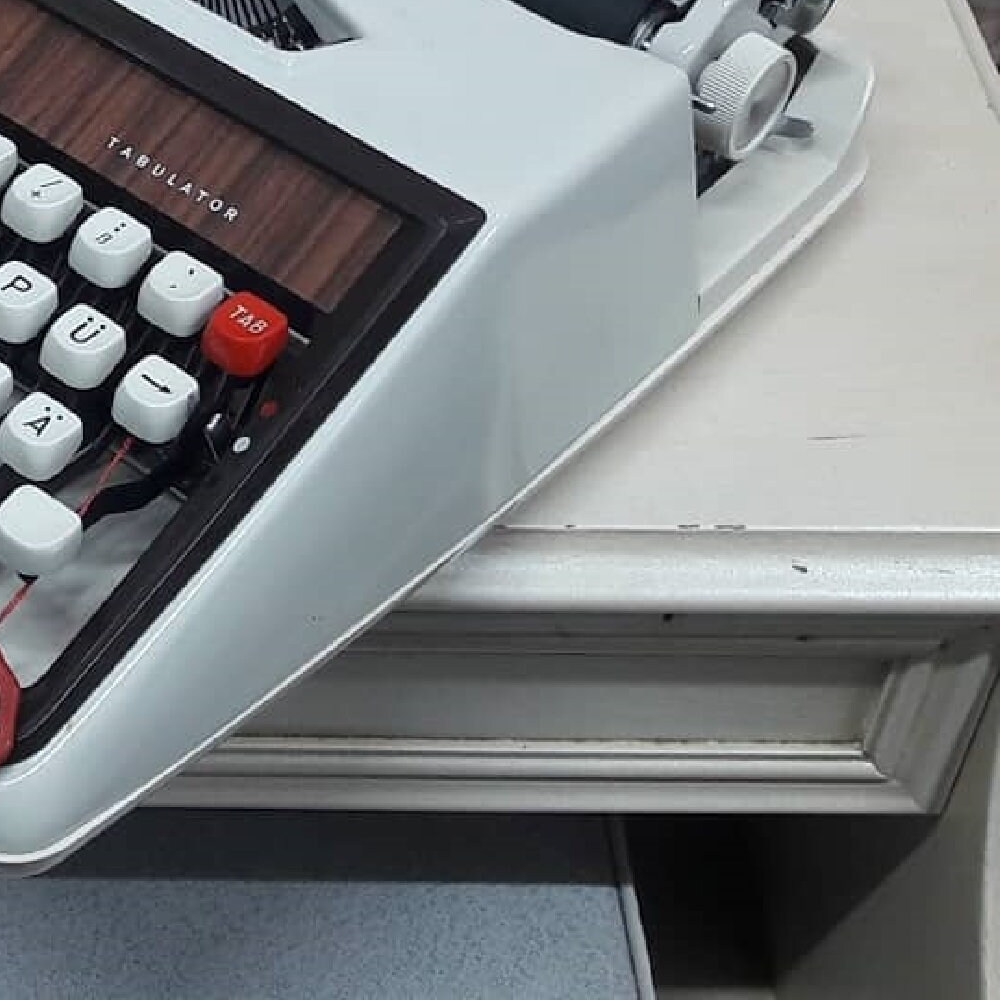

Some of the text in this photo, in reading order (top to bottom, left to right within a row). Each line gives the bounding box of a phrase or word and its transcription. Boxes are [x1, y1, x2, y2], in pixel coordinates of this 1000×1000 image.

[107, 136, 238, 223] TABULATOR
[1, 275, 32, 292] P
[71, 315, 107, 344] Ü
[229, 304, 268, 334] TAB
[23, 406, 64, 436] Ä
